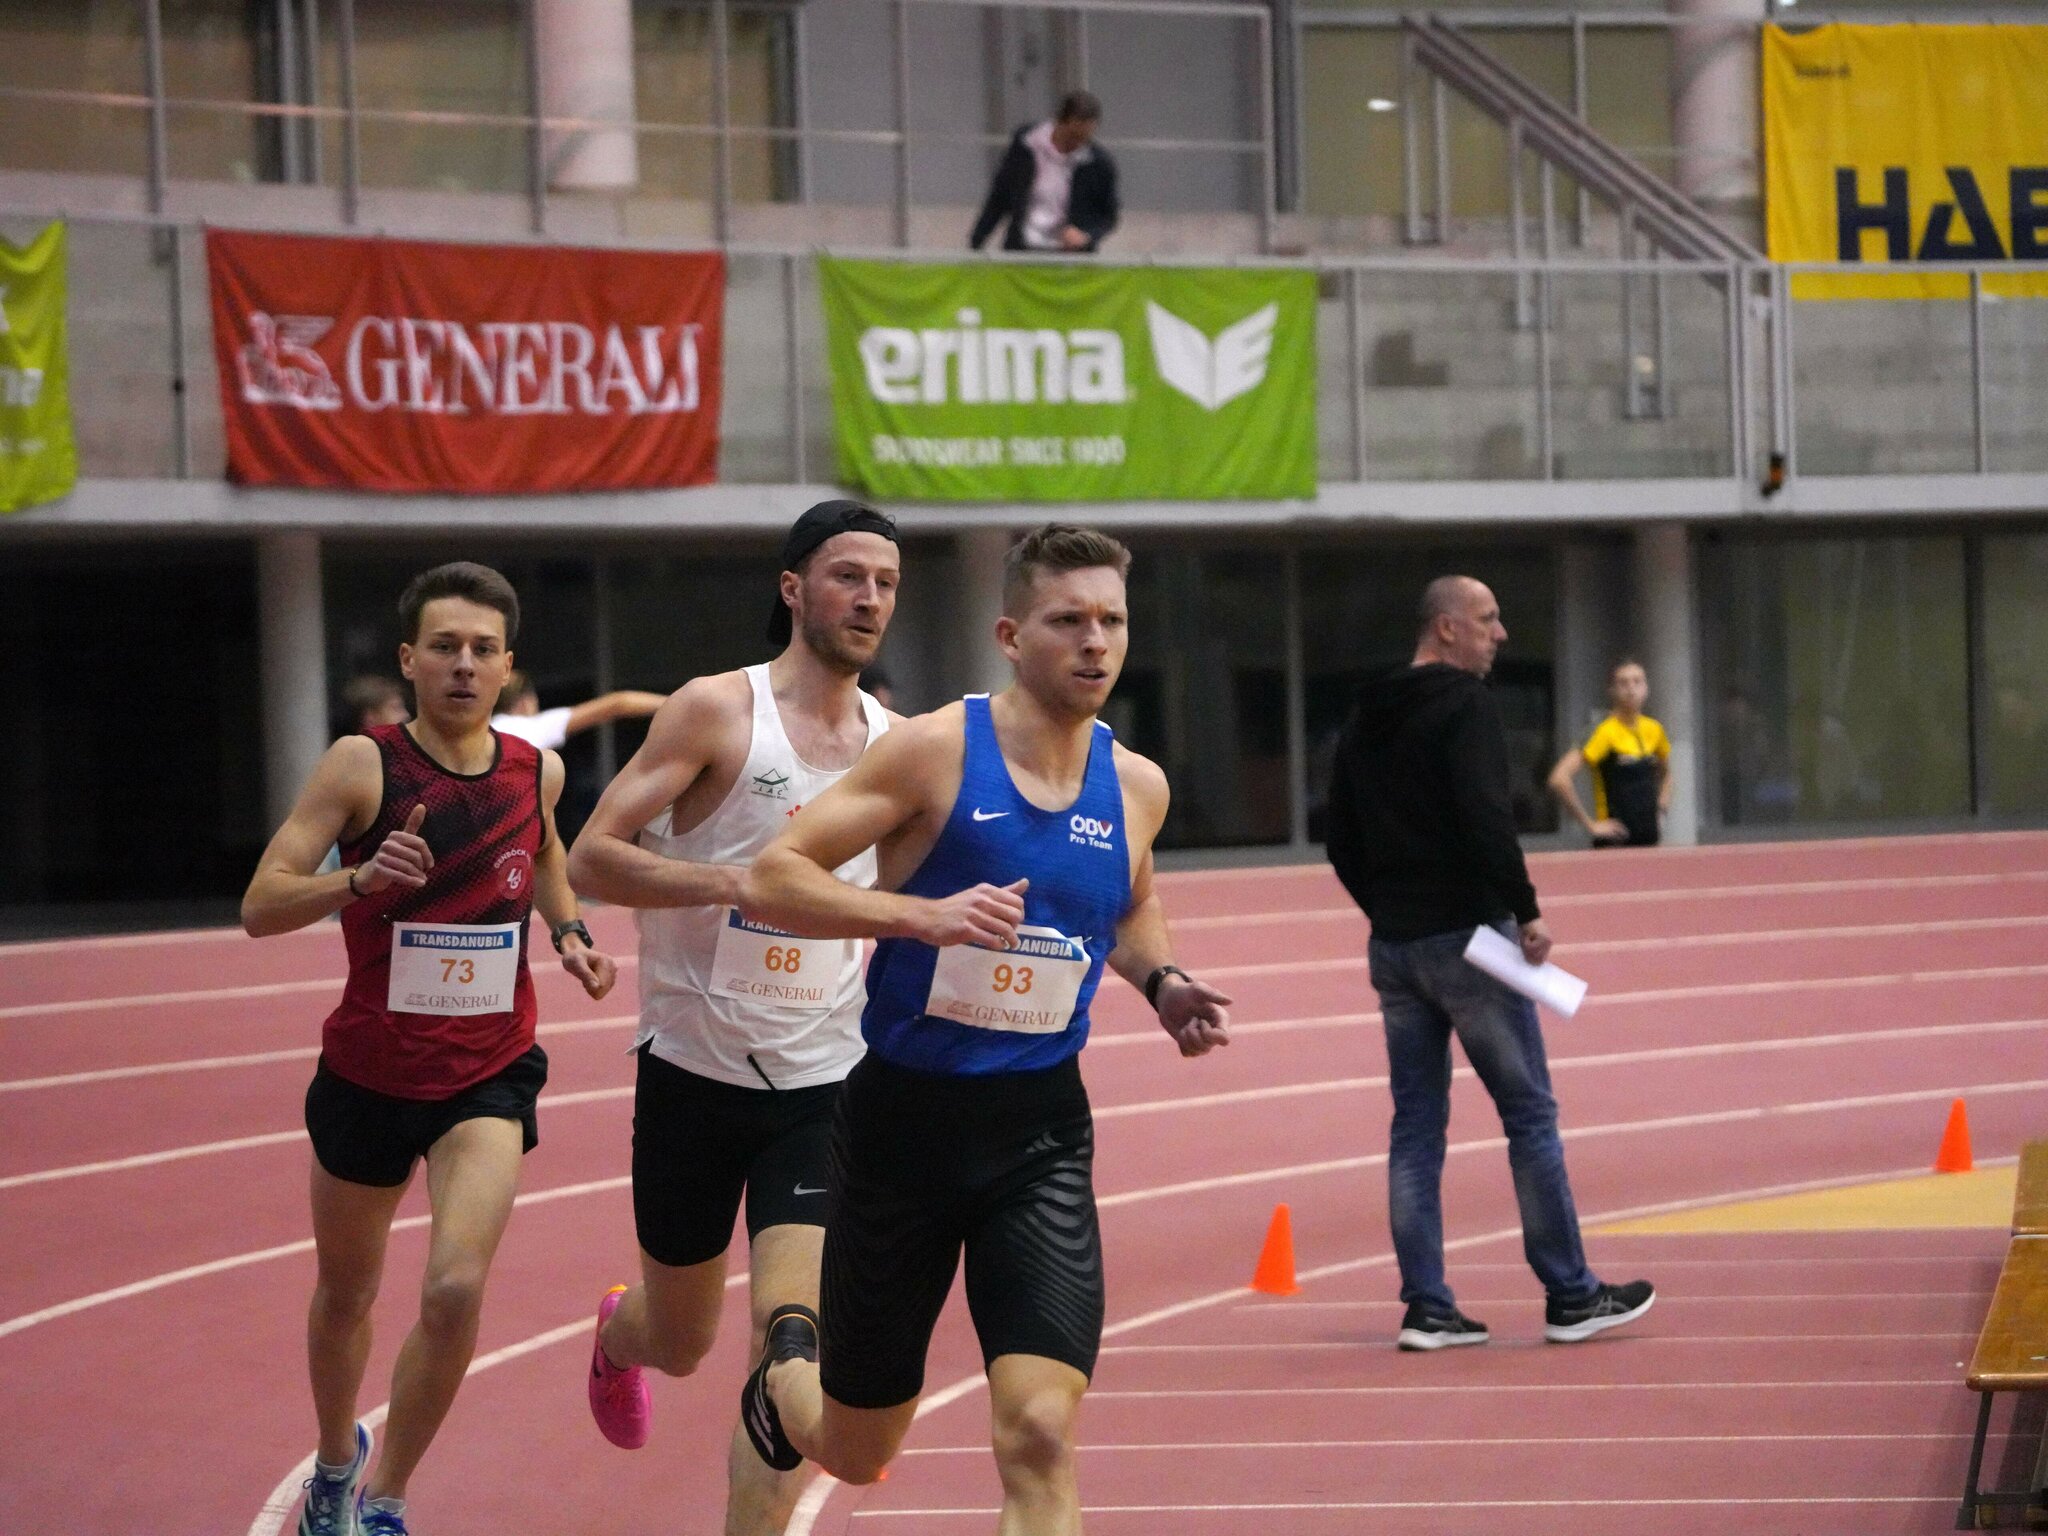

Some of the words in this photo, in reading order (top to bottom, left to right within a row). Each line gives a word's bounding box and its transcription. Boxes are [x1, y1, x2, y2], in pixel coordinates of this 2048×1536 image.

[346, 315, 702, 415] GENERALI
[860, 307, 1126, 405] erima
[1069, 833, 1086, 845] Pro
[1088, 836, 1113, 851] Team
[412, 933, 504, 948] TRANSDANUBIA
[440, 958, 475, 984] 73
[765, 945, 801, 974] 68
[992, 963, 1034, 995] 93
[429, 993, 500, 1009] GENERALI
[751, 982, 824, 1001] GENERALI
[975, 1005, 1059, 1026] GENERALI
